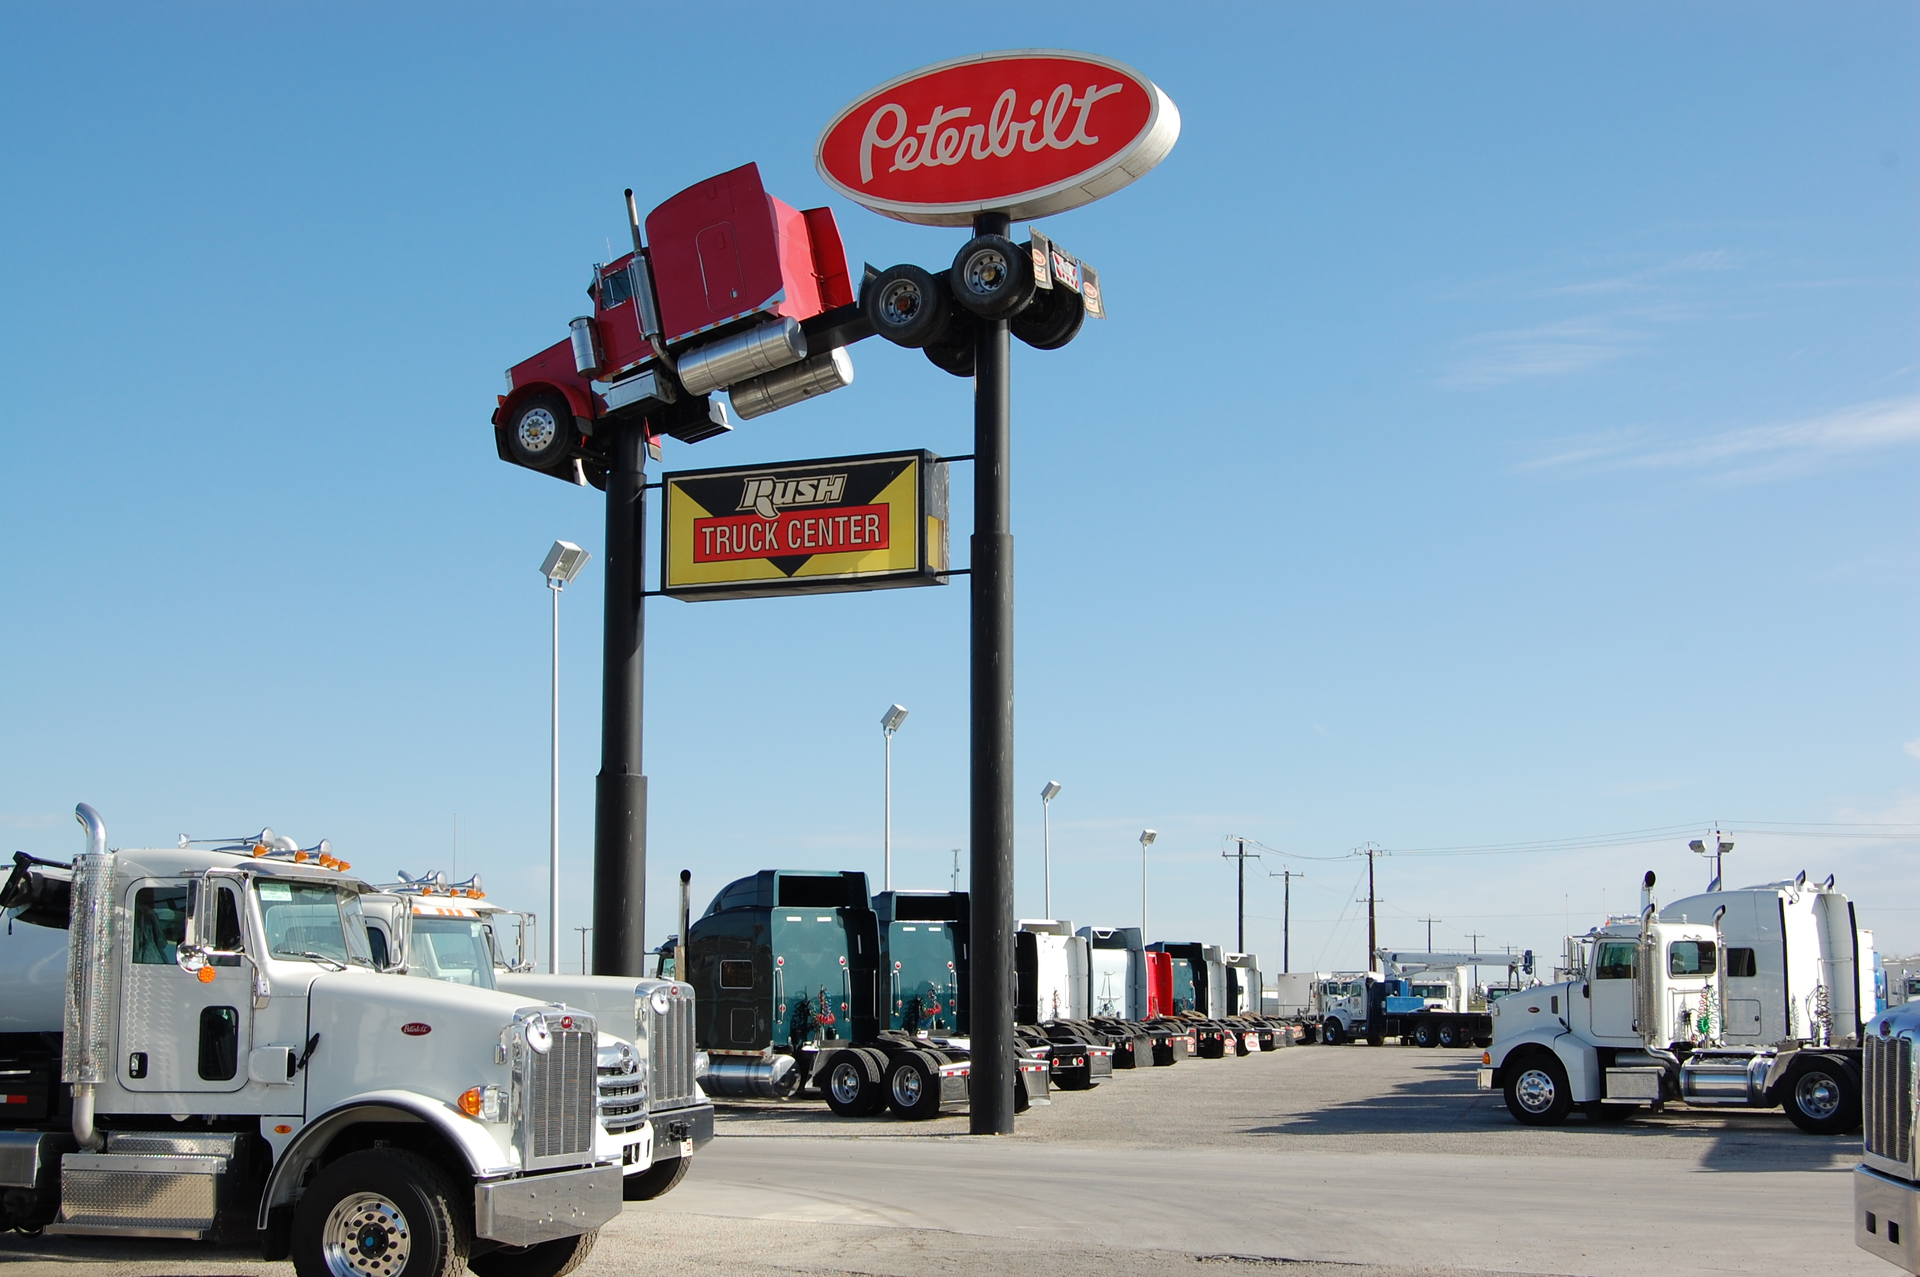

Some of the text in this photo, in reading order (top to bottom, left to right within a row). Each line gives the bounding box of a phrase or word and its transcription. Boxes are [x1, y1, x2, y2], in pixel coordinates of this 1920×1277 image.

[859, 83, 1124, 184] Peterbilt
[735, 473, 848, 520] RUSH
[701, 513, 881, 555] TRUCK CENTER
